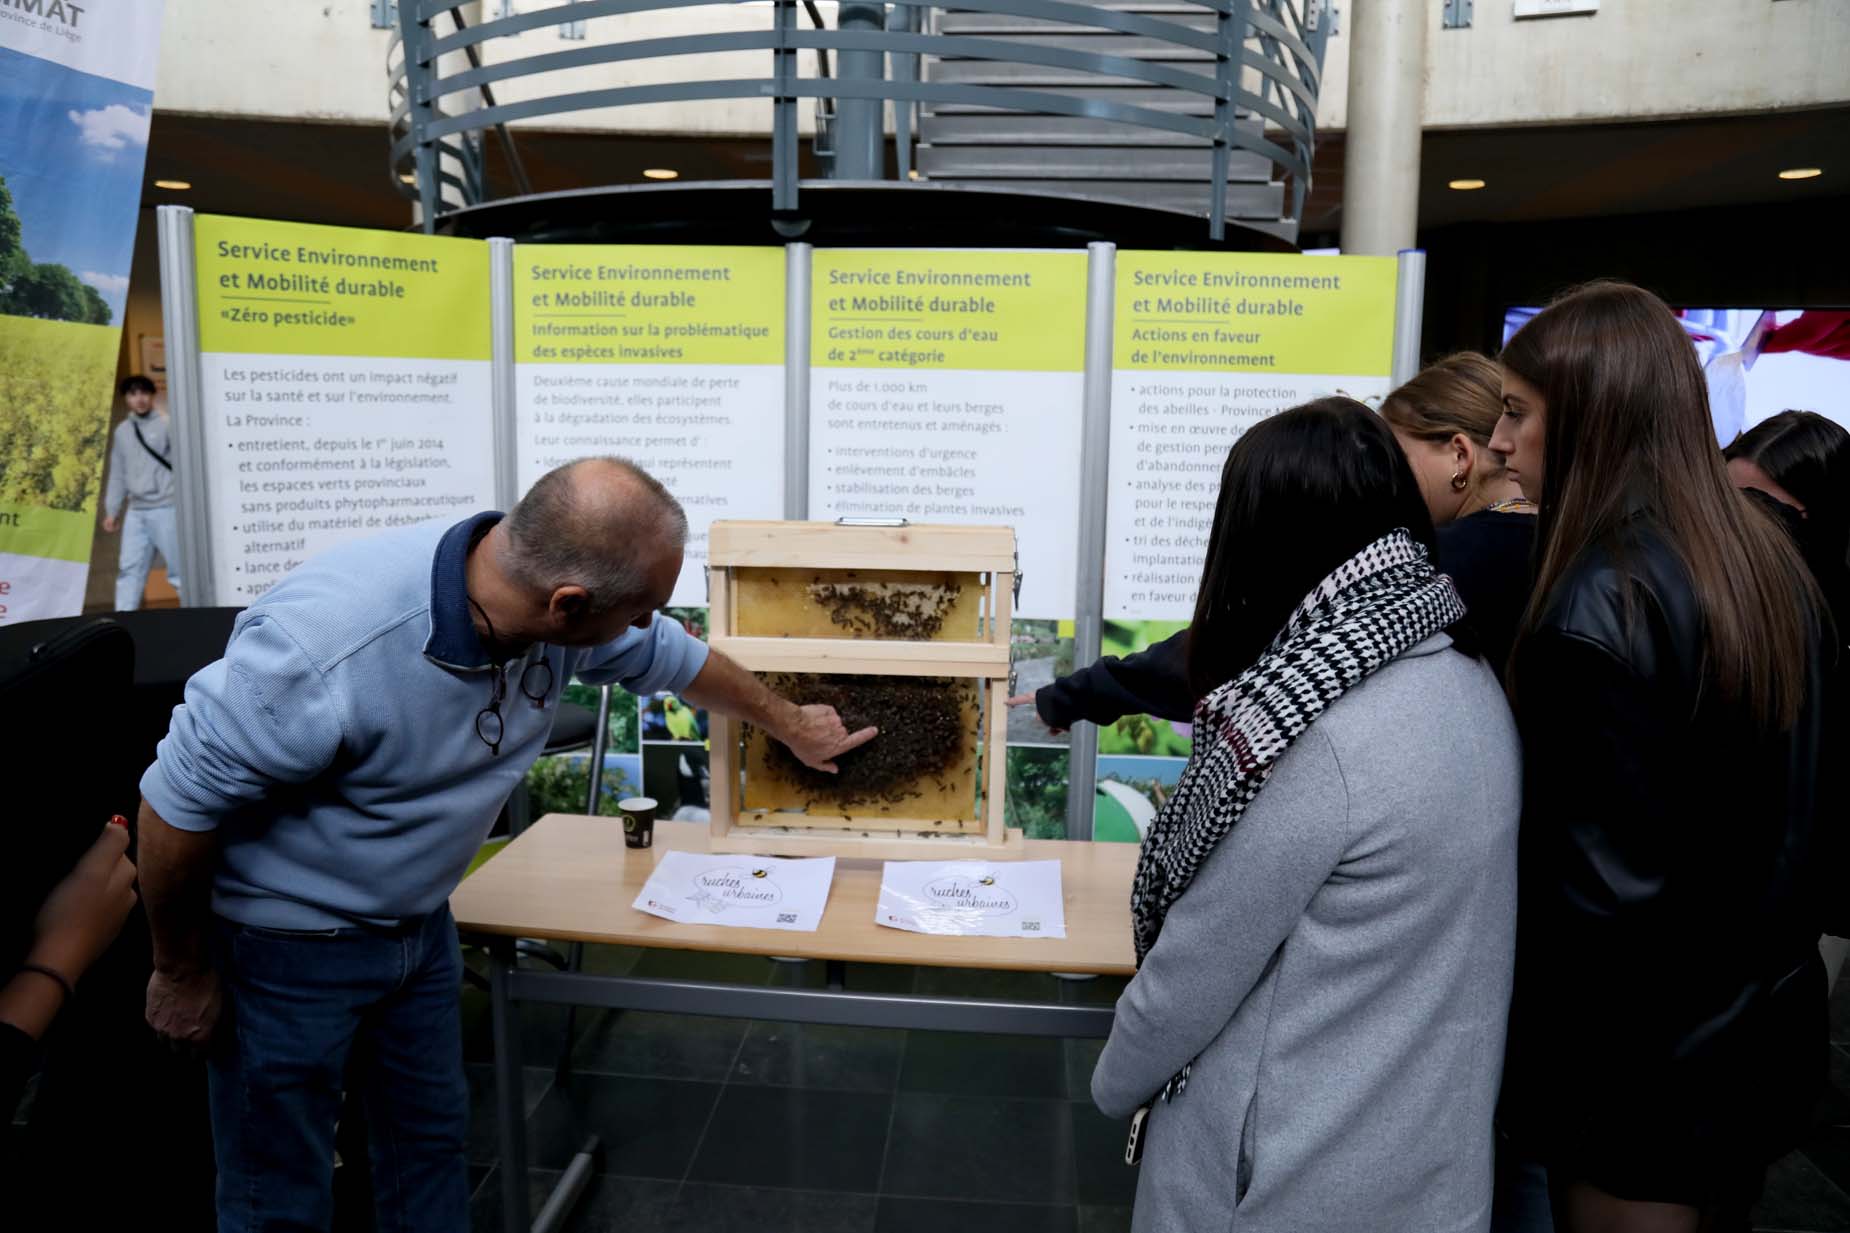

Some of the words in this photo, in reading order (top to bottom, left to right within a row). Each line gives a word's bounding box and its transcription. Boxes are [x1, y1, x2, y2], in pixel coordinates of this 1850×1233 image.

[218, 241, 291, 262] Service
[297, 247, 438, 273] Environnement
[531, 265, 592, 280] Service
[598, 265, 731, 280] Environnement
[829, 268, 891, 285] Service
[896, 270, 1032, 287] Environnement
[1134, 269, 1198, 287] Service
[1203, 271, 1341, 290] Environnement
[220, 274, 240, 289] et
[247, 273, 330, 294] Mobilité
[336, 278, 405, 298] durable
[532, 294, 549, 307] et
[555, 291, 626, 307] Mobilité
[631, 292, 696, 307] durable
[829, 298, 846, 311] et
[852, 295, 924, 312] Mobilité
[929, 296, 995, 313] durable
[1133, 299, 1150, 313] et
[1157, 297, 1231, 314] Mobilité
[1236, 299, 1304, 316] durable
[221, 308, 268, 323] «Zéro
[274, 311, 355, 327] pesticide»
[532, 323, 618, 336] Information
[622, 326, 643, 336] sur
[649, 324, 660, 336] la
[664, 324, 769, 340] problématique
[828, 326, 883, 340] Gestion
[888, 328, 912, 340] des
[916, 330, 954, 341] cours
[959, 328, 998, 341] d'eau
[1132, 328, 1188, 342] Actions
[1191, 331, 1209, 342] en
[1214, 329, 1261, 344] faveur
[533, 345, 557, 358] des
[561, 345, 614, 360] espèces
[619, 345, 683, 358] invasives
[828, 348, 845, 361] de
[878, 349, 945, 366] catégorie
[1131, 350, 1149, 364] de
[1152, 350, 1275, 367] l'environnement
[224, 369, 246, 381] Les
[250, 369, 319, 384] pesticides
[323, 371, 345, 383] ont
[350, 372, 366, 383] un
[370, 372, 413, 386] impact
[417, 373, 457, 387] négatif
[533, 376, 592, 388] Deuxième
[597, 378, 628, 388] cause
[633, 377, 688, 388] mondiale
[692, 377, 704, 388] de
[709, 379, 740, 390] perte
[828, 381, 853, 393] Plus
[856, 382, 871, 392] de
[909, 382, 928, 393] km
[1139, 384, 1184, 396] actions
[1188, 386, 1216, 398] pour
[1219, 385, 1230, 396] la
[1233, 387, 1297, 399] protection
[225, 391, 246, 402] sur
[251, 389, 262, 402] la
[266, 390, 304, 402] santé
[308, 392, 321, 402] et
[325, 393, 345, 403] sur
[533, 395, 548, 405] de
[552, 395, 624, 407] biodiversité,
[628, 395, 654, 406] elles
[657, 396, 721, 408] participent
[827, 400, 842, 411] de
[845, 402, 878, 412] cours
[881, 401, 914, 412] d'eau
[917, 402, 929, 412] et
[932, 402, 962, 413] leurs
[965, 403, 1004, 416] berges
[1138, 403, 1160, 414] des
[1163, 404, 1209, 415] abeilles
[1221, 404, 1272, 417] Province
[226, 415, 241, 427] La
[246, 414, 303, 427] Province
[558, 413, 628, 426] dégradation
[632, 413, 652, 424] des
[828, 419, 854, 429] sont
[857, 420, 923, 431] entretenus
[926, 420, 938, 431] et
[941, 420, 1002, 435] aménagés
[1138, 422, 1167, 433] mise
[1171, 424, 1185, 433] en
[1189, 425, 1228, 435] œuvre
[238, 439, 310, 452] entretient,
[314, 438, 357, 453] depuis
[361, 438, 372, 450] le
[391, 439, 414, 452] juin
[418, 439, 444, 450] 2014
[534, 436, 560, 446] Leur
[563, 436, 641, 446] connaissance
[645, 436, 686, 448] permet
[1137, 441, 1152, 451] de
[1155, 442, 1200, 455] gestion
[835, 446, 915, 459] interventions
[919, 447, 977, 462] d'urgence
[239, 461, 252, 472] et
[256, 457, 355, 472] conformément
[371, 458, 381, 469] la
[385, 457, 451, 471] législation,
[659, 458, 732, 470] représentent
[835, 464, 905, 476] enlèvement
[909, 465, 976, 478] d'embâcles
[240, 480, 259, 493] les
[263, 480, 314, 494] espaces
[318, 478, 350, 490] verts
[354, 477, 426, 491] provinciaux
[835, 482, 910, 495] stabilisation
[913, 483, 932, 495] des
[936, 484, 975, 497] berges
[1136, 480, 1181, 493] analyse
[1185, 480, 1205, 491] des
[241, 503, 271, 514] sans
[276, 498, 330, 515] produits
[334, 494, 475, 511] phytopharmaceutiques
[835, 500, 902, 513] élimination
[906, 502, 921, 513] de
[924, 503, 968, 516] plantes
[971, 504, 1025, 516] invasives
[1135, 499, 1162, 510] pour
[1167, 498, 1177, 510] le
[243, 521, 283, 534] utilise
[288, 519, 304, 532] du
[308, 515, 362, 530] matériel
[368, 515, 381, 527] de
[1134, 517, 1145, 527] et
[1150, 517, 1164, 527] de
[244, 539, 305, 554] alternatif
[1134, 536, 1147, 545] tri
[1151, 536, 1171, 546] des
[245, 561, 280, 574] lance
[1132, 572, 1194, 584] réalisation
[1131, 592, 1145, 601] en
[1149, 590, 1185, 601] faveur
[701, 873, 741, 889] ruches
[722, 888, 774, 901] urbaines
[931, 883, 972, 898] ruches
[957, 895, 1010, 910] urbaines
